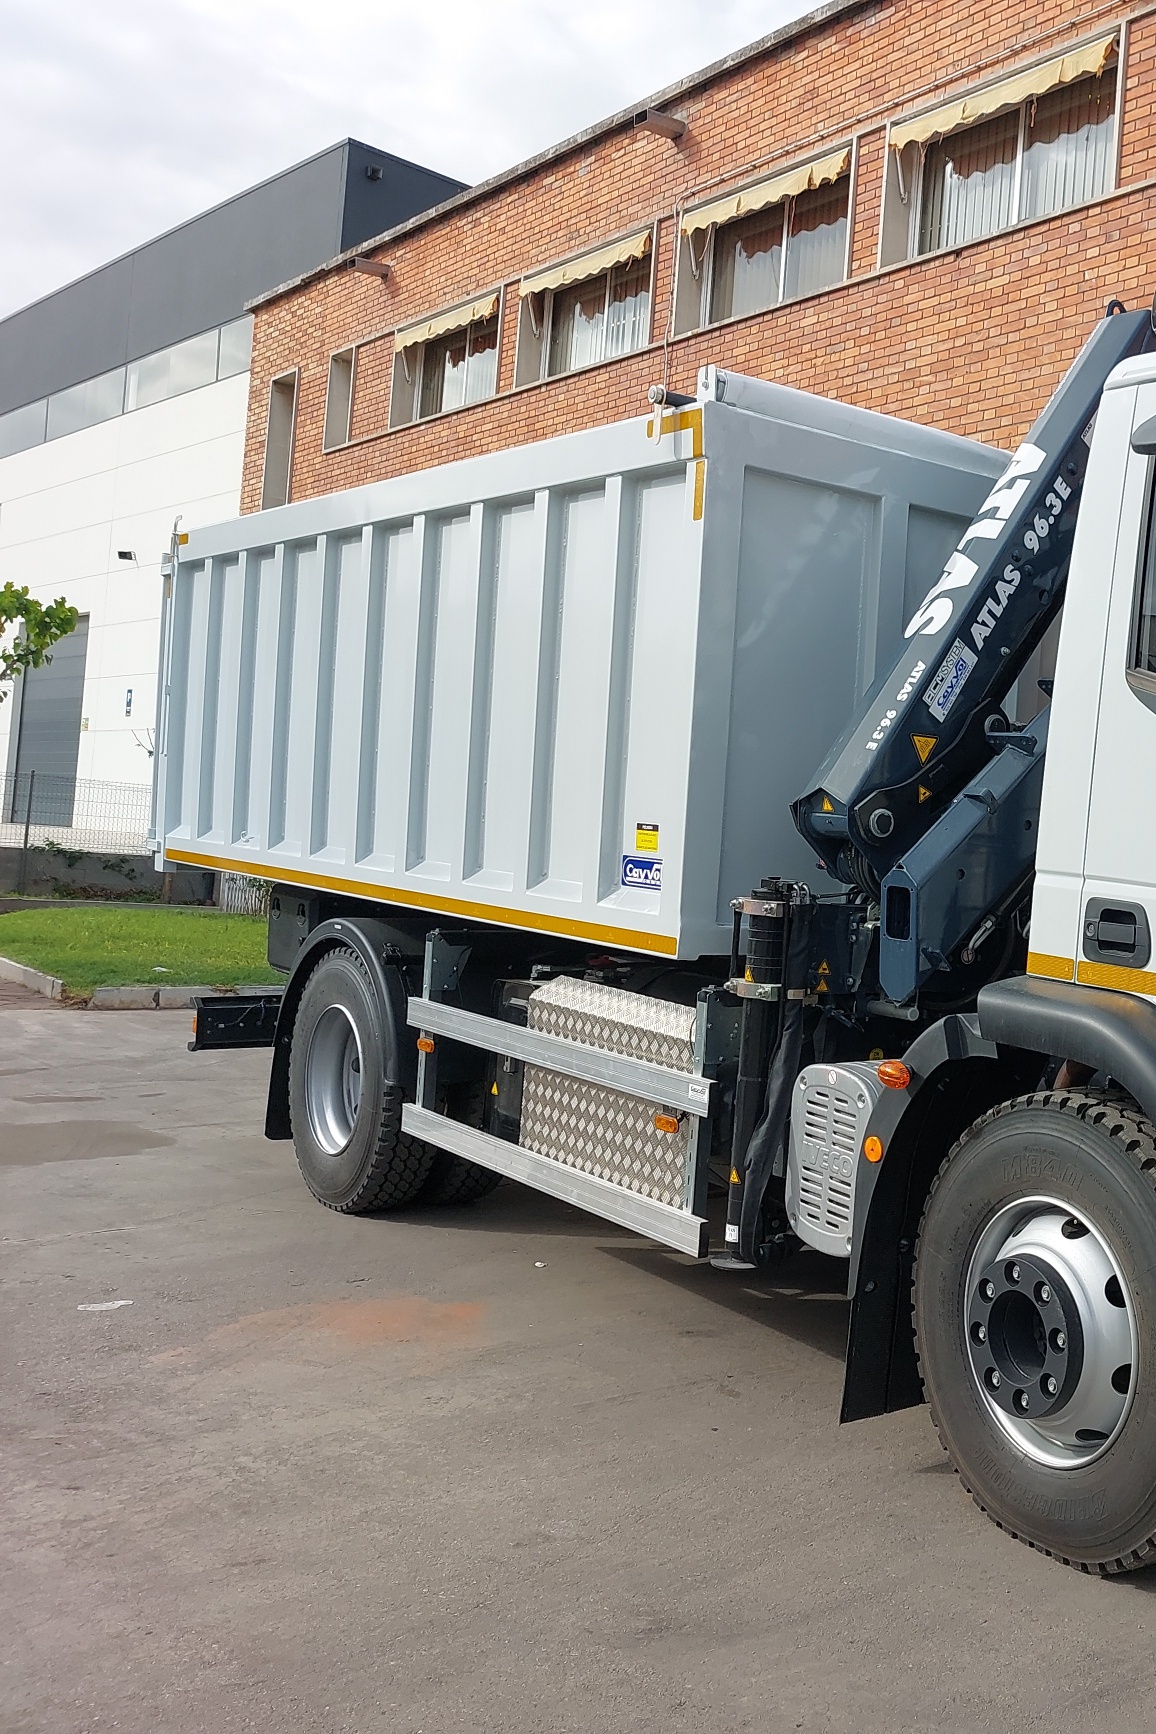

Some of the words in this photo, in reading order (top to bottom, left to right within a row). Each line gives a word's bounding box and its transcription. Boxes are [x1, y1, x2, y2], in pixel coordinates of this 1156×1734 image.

[903, 442, 1048, 640] ATLAS
[970, 563, 1022, 652] ATLAS
[896, 660, 927, 702] ATLAS
[801, 1140, 854, 1179] IVECO
